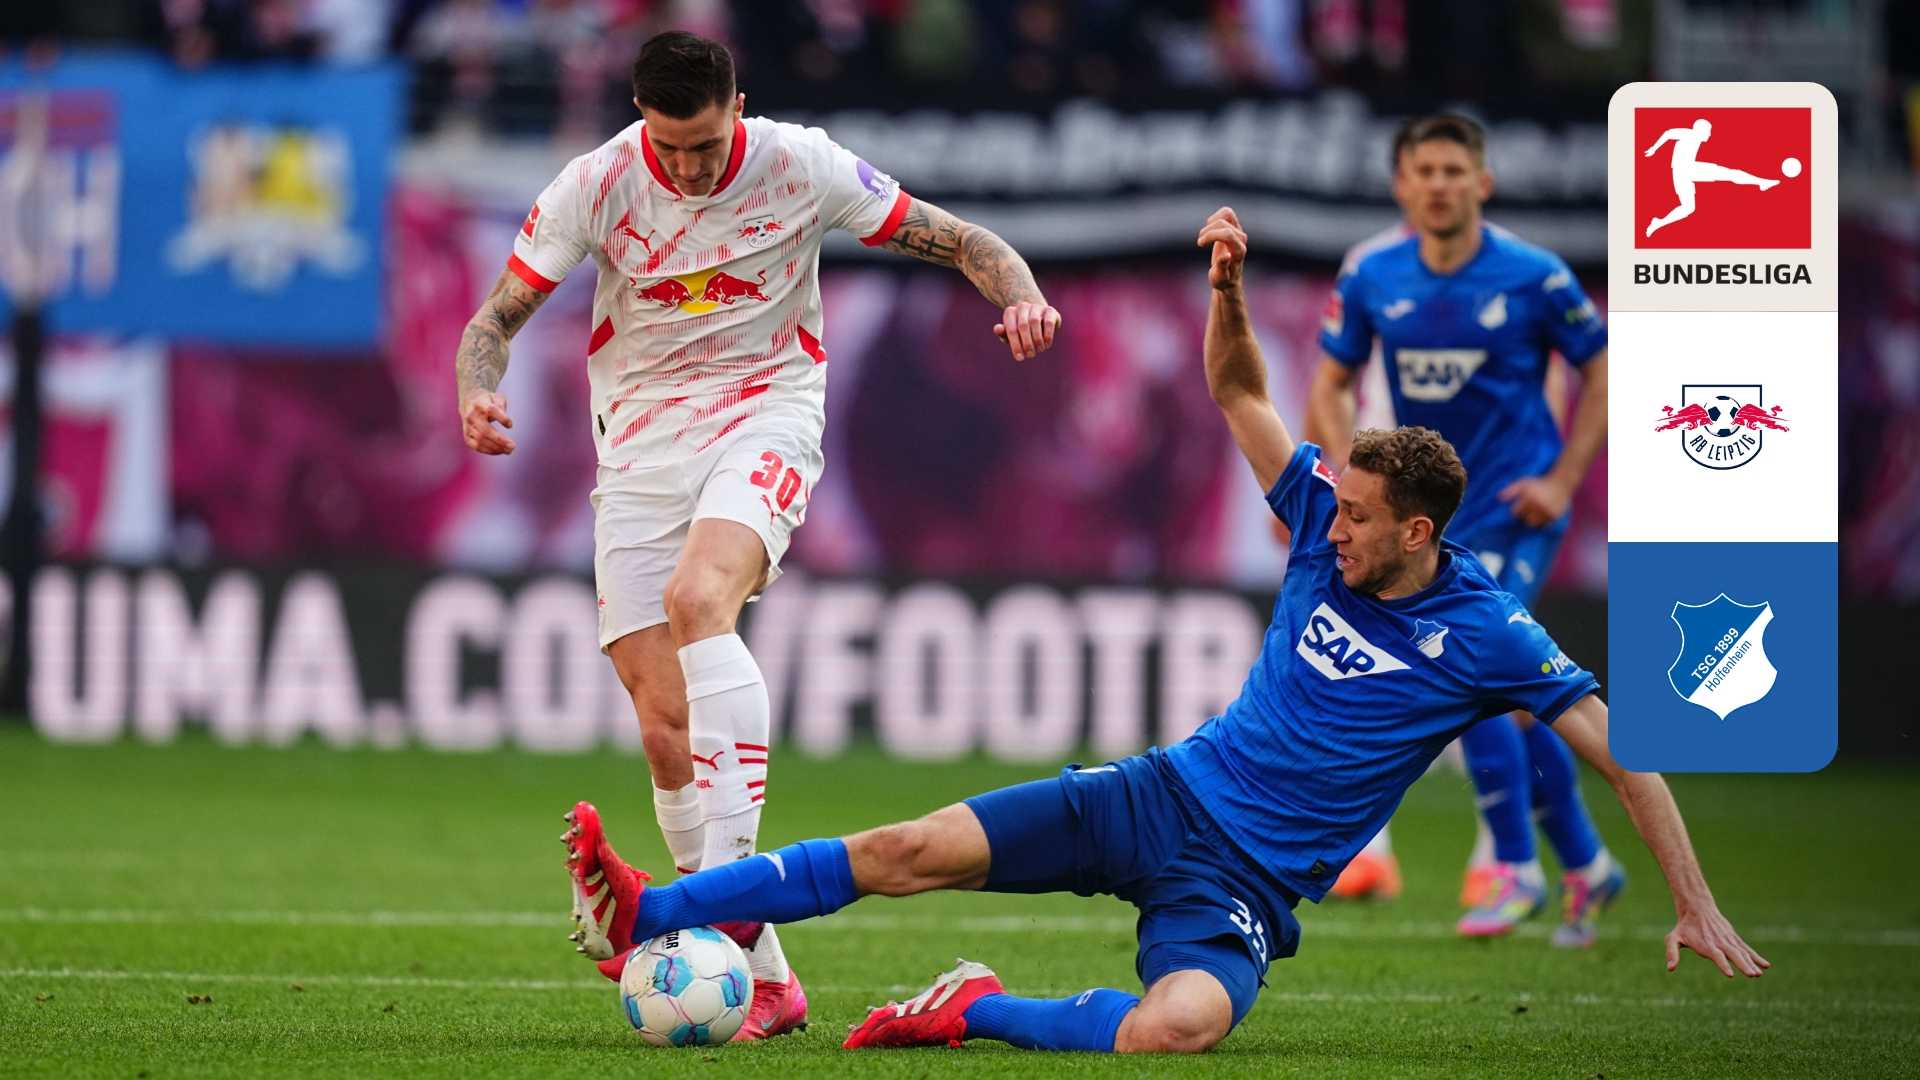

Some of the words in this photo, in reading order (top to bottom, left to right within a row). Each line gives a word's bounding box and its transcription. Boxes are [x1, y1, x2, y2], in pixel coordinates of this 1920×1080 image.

[750, 450, 802, 513] 30
[1302, 614, 1376, 676] SAP
[1229, 896, 1267, 965] 35
